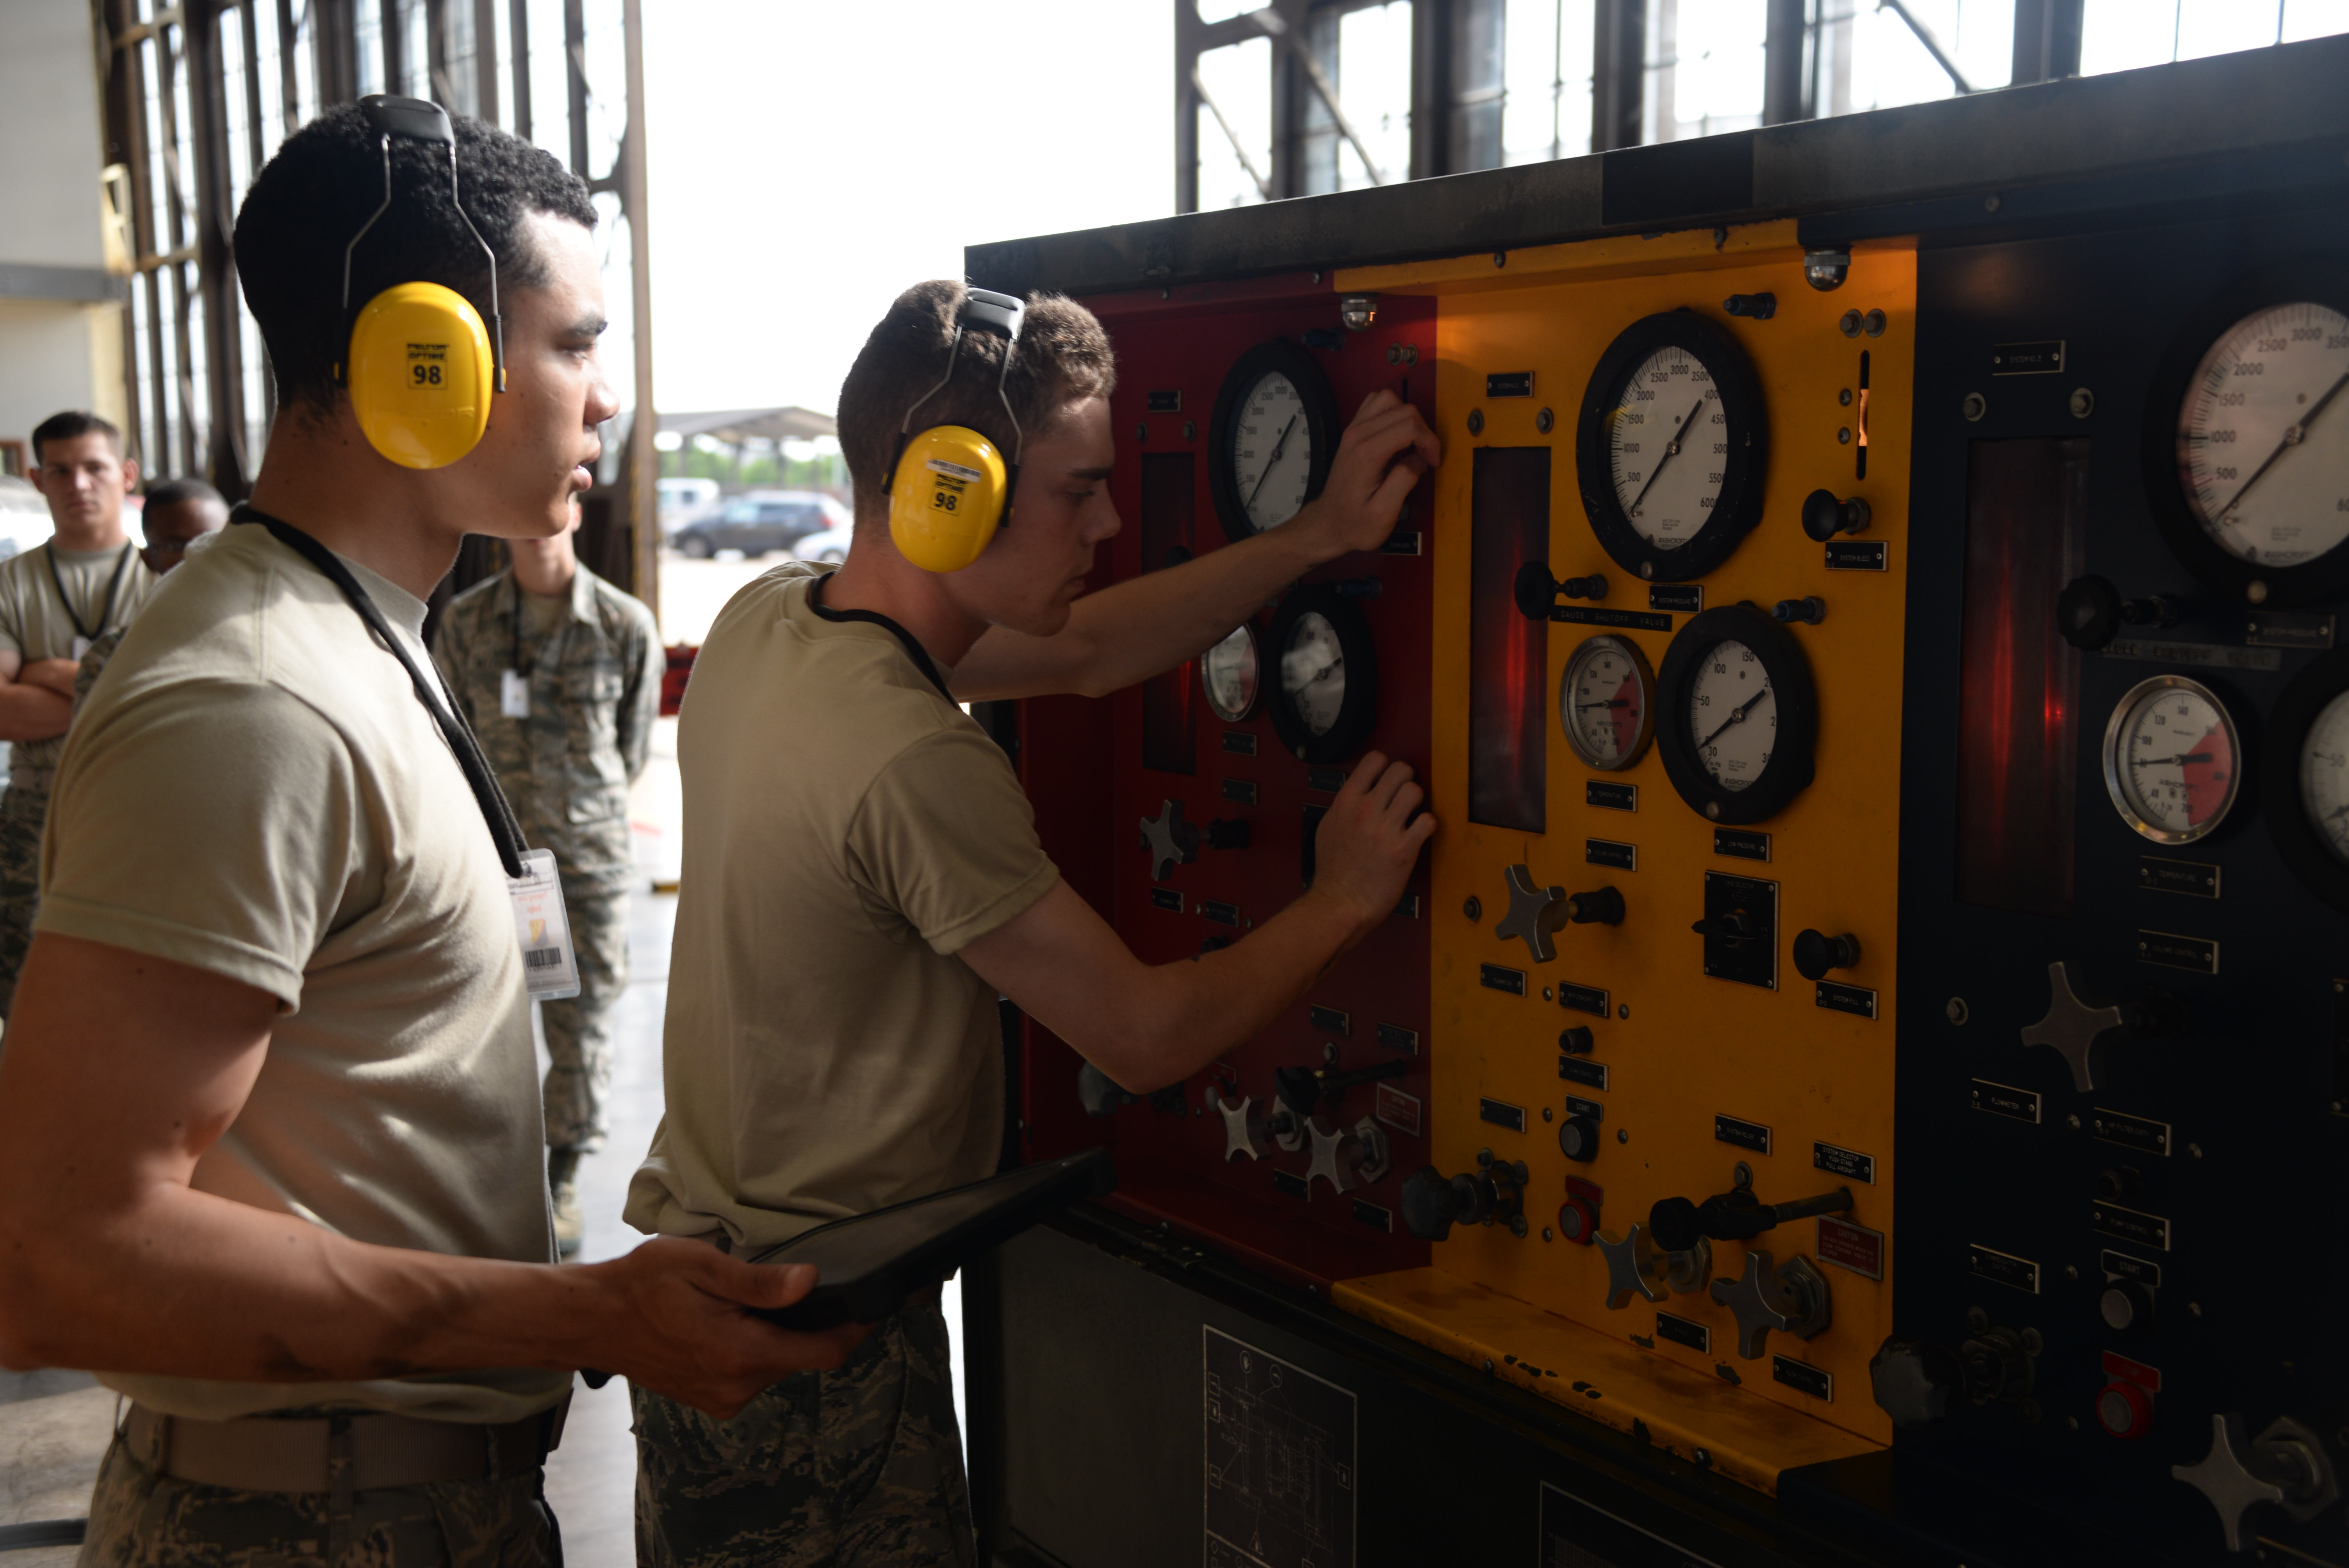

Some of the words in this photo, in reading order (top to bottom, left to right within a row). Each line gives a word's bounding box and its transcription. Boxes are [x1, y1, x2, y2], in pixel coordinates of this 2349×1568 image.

[2291, 327, 2322, 342] 3000
[2258, 339, 2287, 352] 2500
[2010, 355, 2029, 363] SYSTEM
[414, 365, 442, 385] 98
[1670, 365, 1689, 374] 3000
[2233, 363, 2263, 376] 2000
[1651, 372, 1668, 382] 2500
[1691, 371, 1709, 381] 3500
[1262, 392, 1273, 400] 2500
[1637, 391, 1655, 401] 2000
[2219, 393, 2245, 406] 1500
[1628, 414, 1644, 424] 1500
[2211, 431, 2236, 443] 1000
[1624, 443, 1640, 453] 1000
[1627, 472, 1641, 482] 500
[2216, 468, 2237, 480] 500
[934, 492, 957, 511] 98
[1560, 611, 1585, 620] GAUGE
[1595, 613, 1630, 623] SHUTOFF
[1640, 617, 1665, 627] VALVE
[1742, 651, 1755, 663] 150
[1714, 664, 1726, 674] 100
[1700, 695, 1710, 706] 50
[2178, 706, 2189, 715] 140
[2155, 715, 2165, 725] 120
[2142, 735, 2152, 745] 100
[1708, 746, 1718, 757] 30
[2330, 753, 2345, 767] 50
[2151, 788, 2159, 798] 40
[1737, 841, 1756, 850] PRESSURE
[1833, 994, 1849, 1003] SYSTEM
[1849, 998, 1859, 1006] FILL
[1576, 1102, 1590, 1113] START
[1991, 1097, 2019, 1110] FLOWMETER
[1727, 1127, 1741, 1137] SYSTEM
[1741, 1130, 1756, 1140] RELIEF
[2117, 1124, 2133, 1133] FILTER
[1822, 1146, 1838, 1156] SYSTEM
[1839, 1151, 1859, 1162] SELECTOR
[1840, 1158, 1853, 1167] STAND
[1825, 1162, 1836, 1170] PULL
[1837, 1164, 1857, 1175] AIRCRAFT
[2124, 1222, 2149, 1235] CONTROL
[1837, 1228, 1859, 1242] CAUTION
[2118, 1262, 2140, 1276] START
[1785, 1369, 1797, 1380] FLOW
[1798, 1374, 1815, 1385] CONTROL
